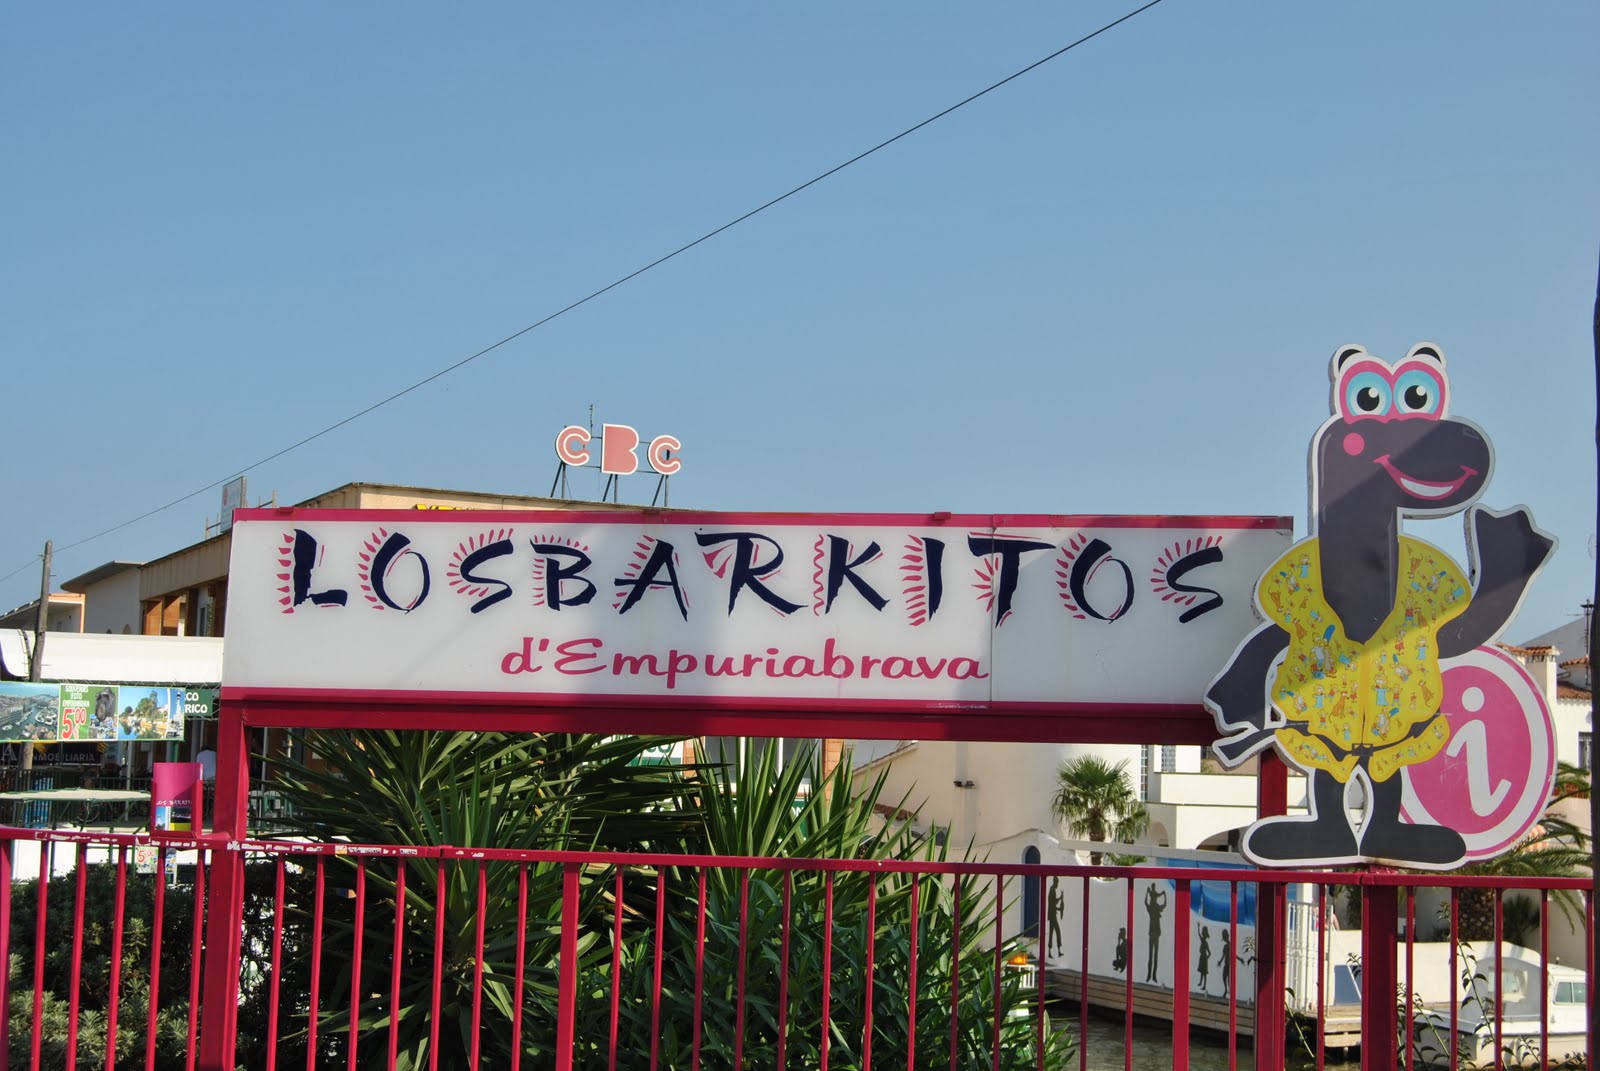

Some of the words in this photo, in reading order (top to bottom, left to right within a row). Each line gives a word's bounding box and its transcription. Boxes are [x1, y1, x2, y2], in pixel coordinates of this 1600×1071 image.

[556, 423, 681, 475] CBC
[502, 637, 988, 688] d'Empuriabrava
[184, 704, 208, 714] RICO
[33, 753, 95, 762] NMOBILIARIA
